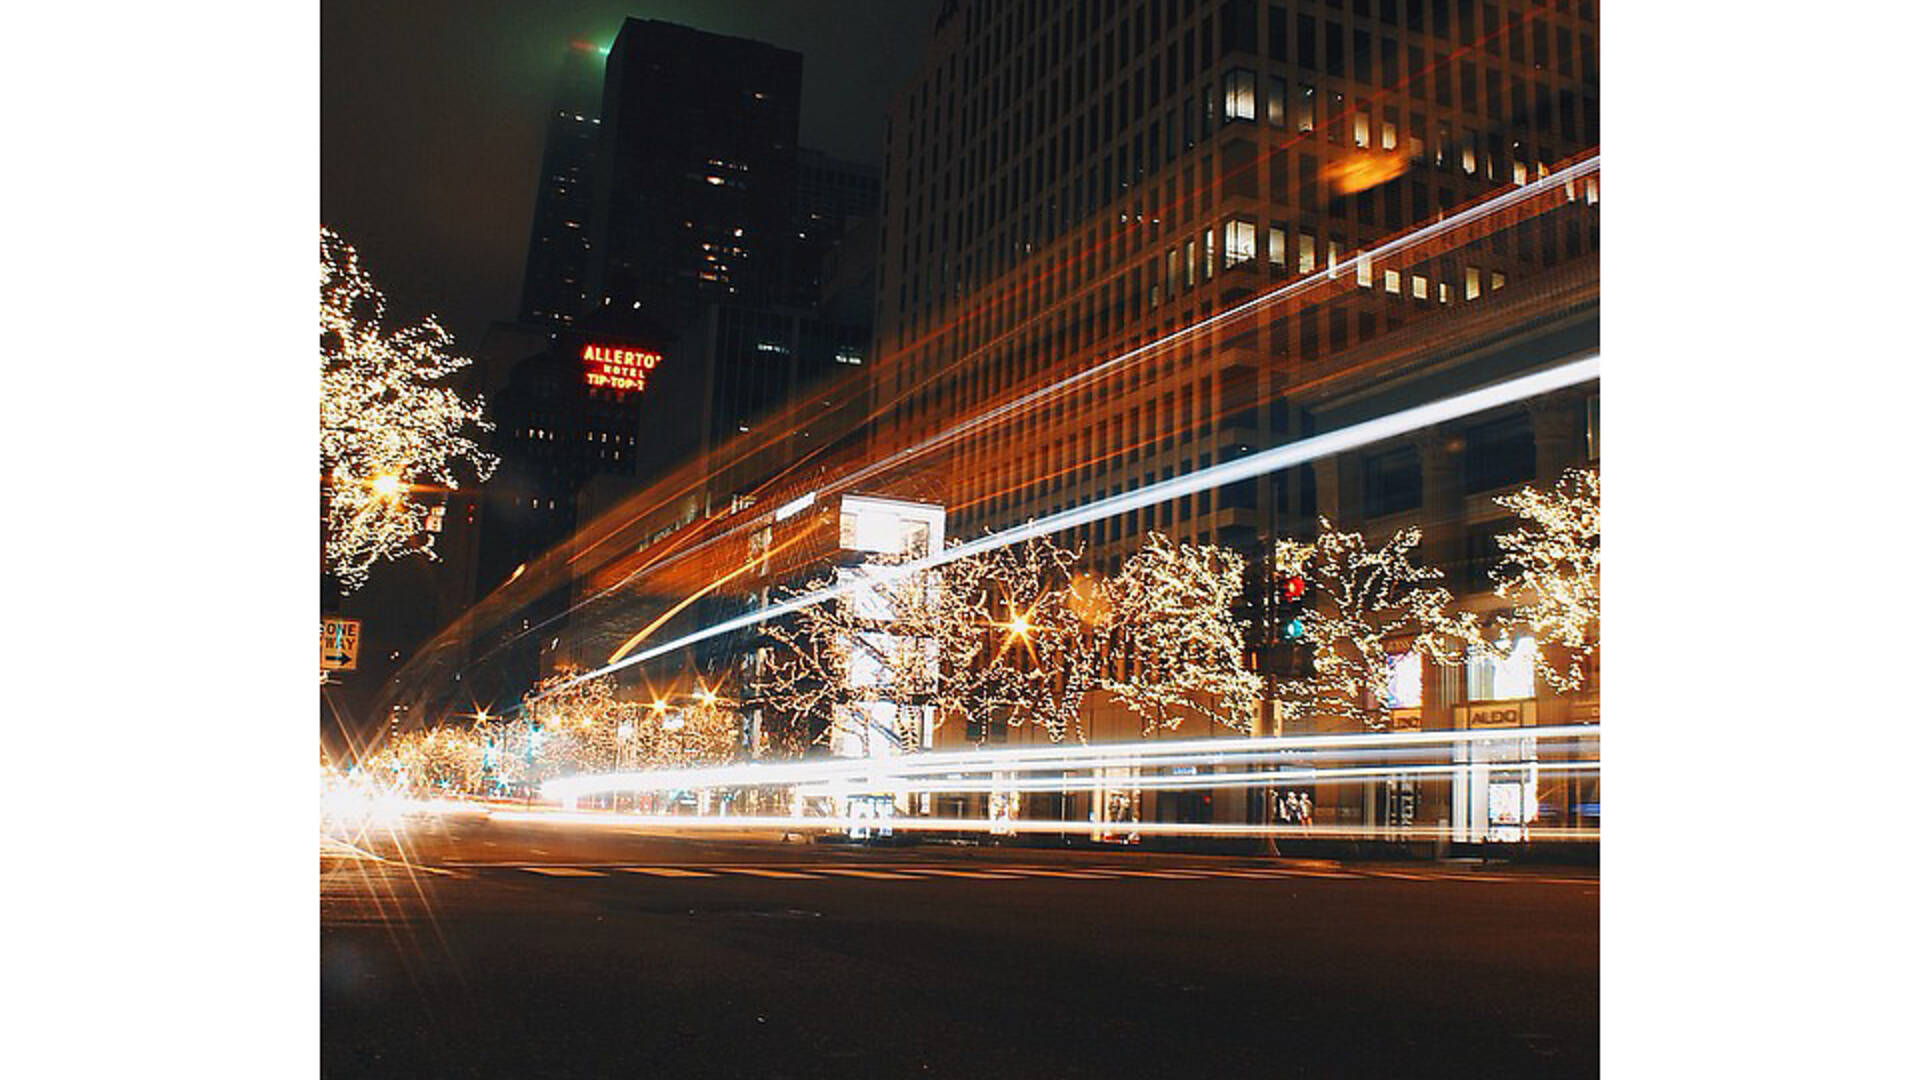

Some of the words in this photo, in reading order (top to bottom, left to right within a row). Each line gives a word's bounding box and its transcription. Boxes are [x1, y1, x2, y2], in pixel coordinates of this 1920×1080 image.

[583, 345, 661, 369] ALLERTO
[603, 363, 645, 379] HOTEL
[327, 623, 356, 637] ONE
[325, 636, 356, 650] WAY
[1471, 709, 1518, 724] ALDO
